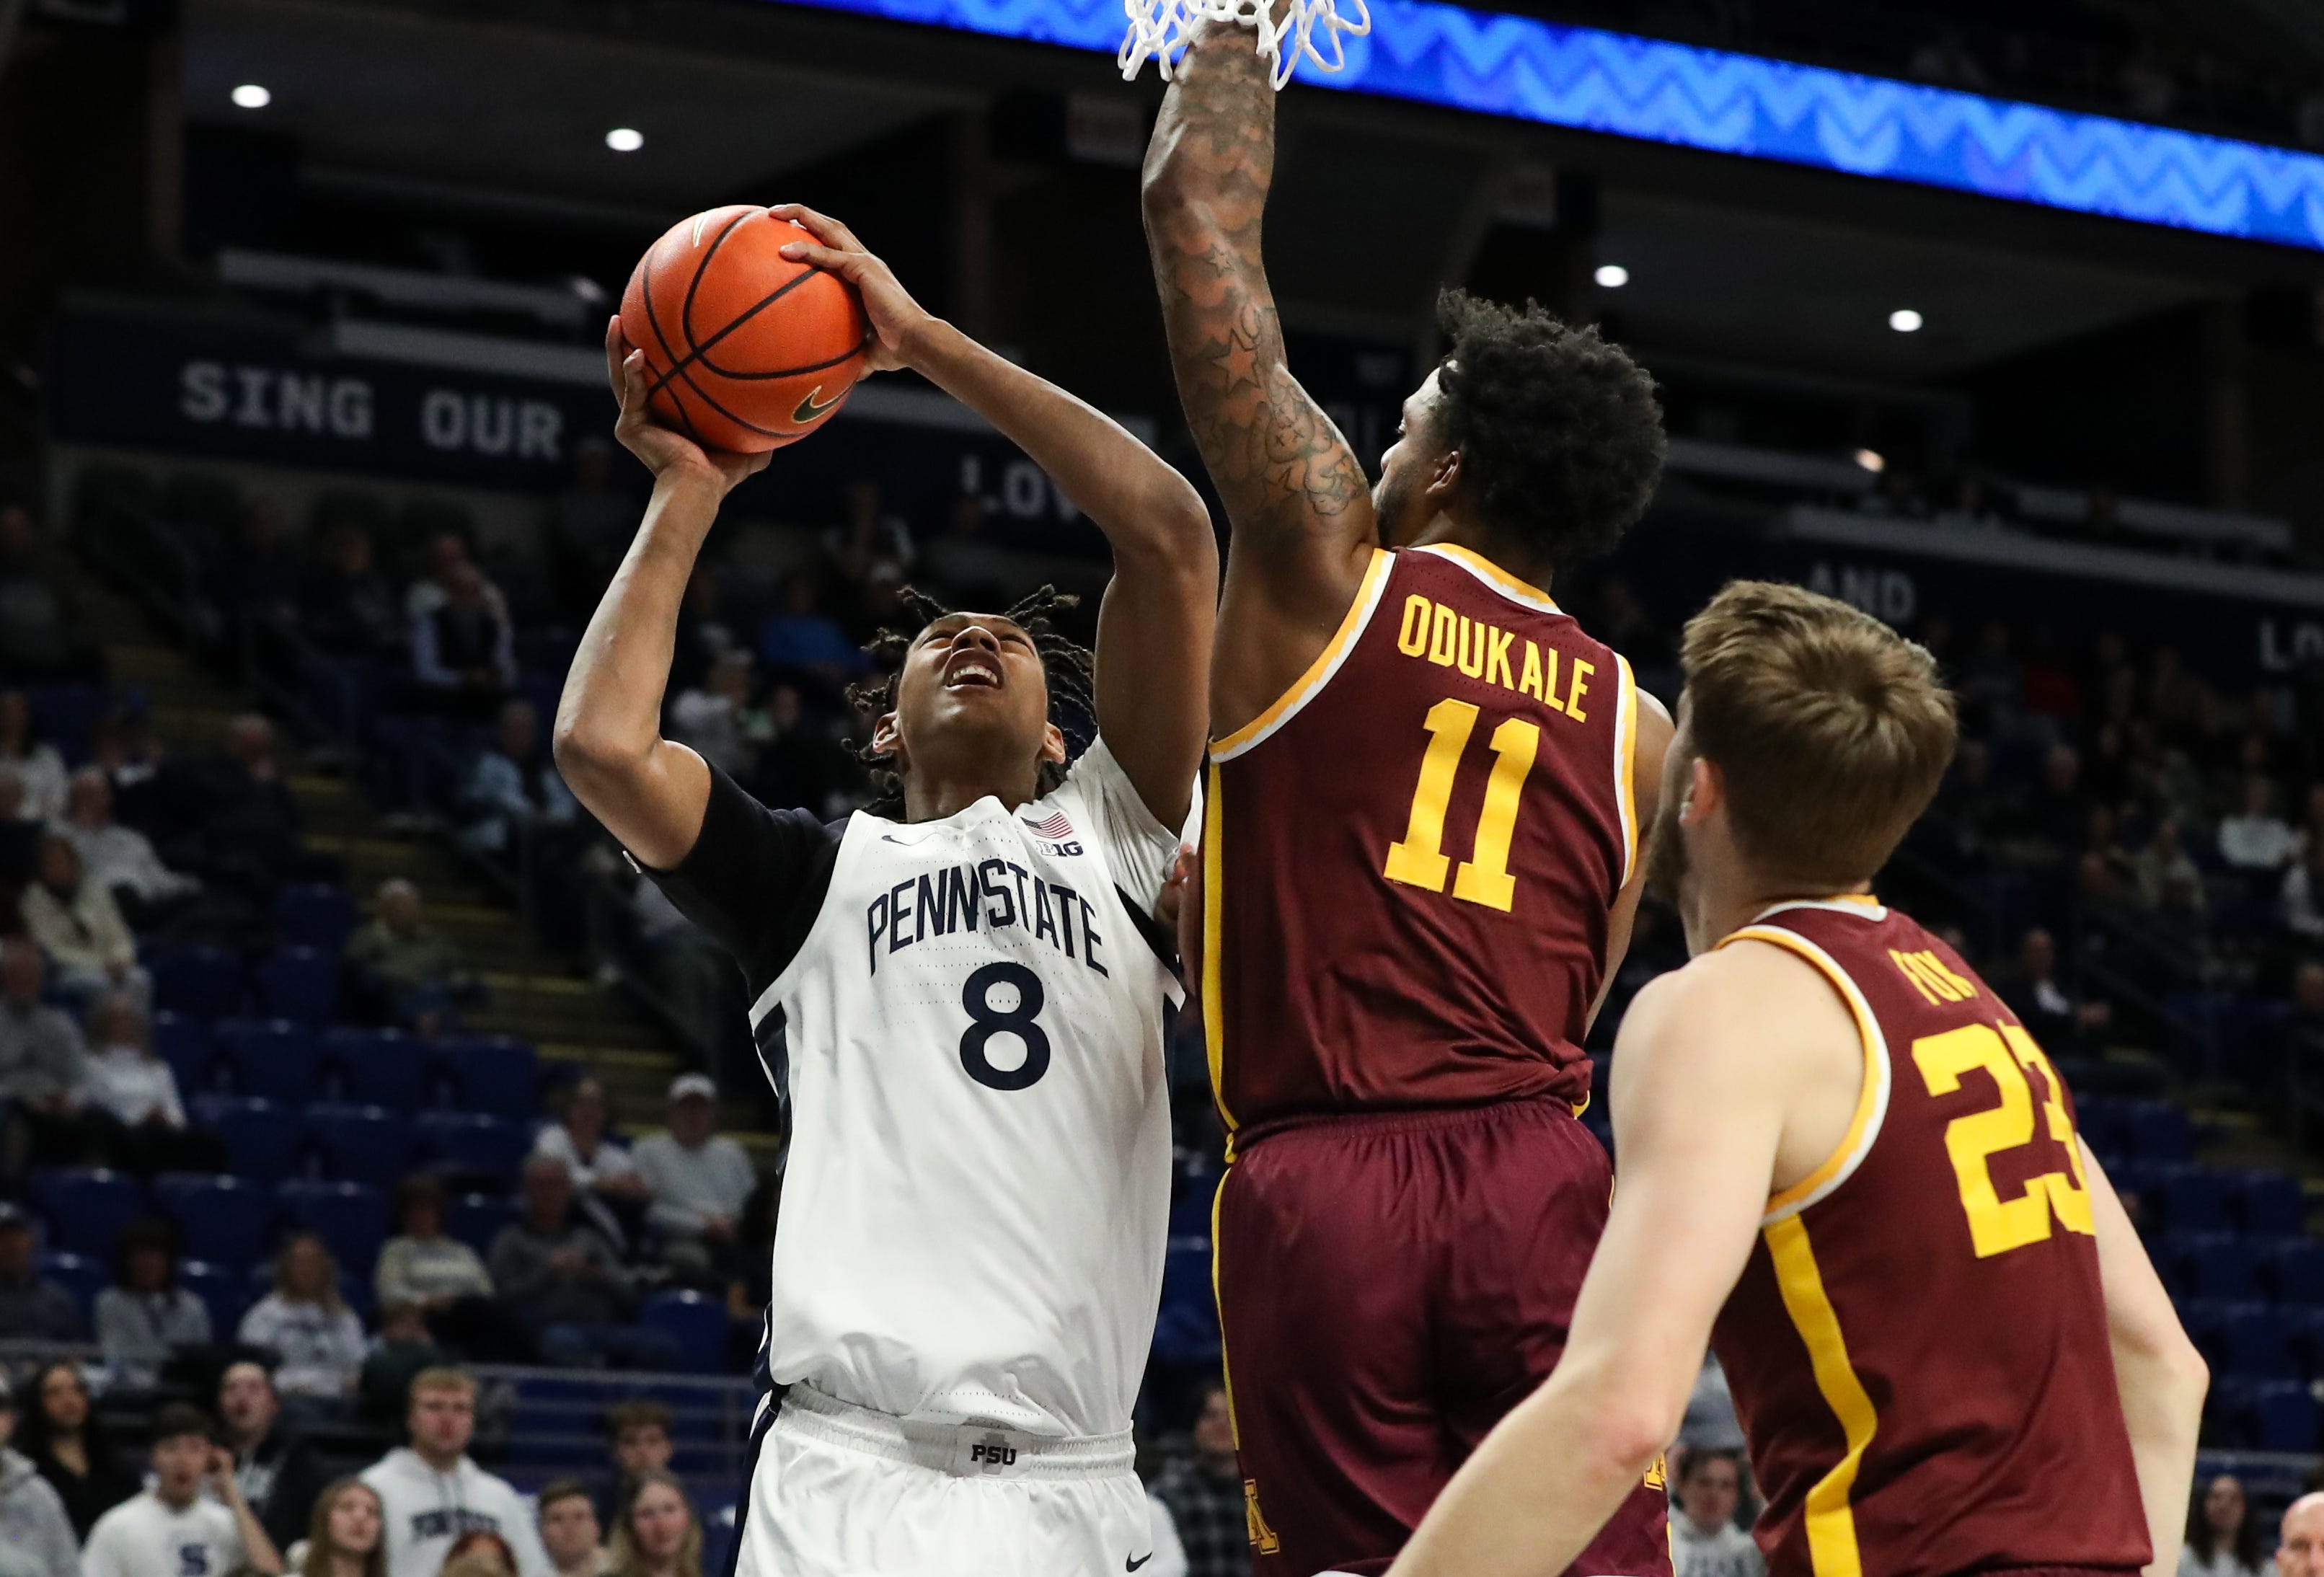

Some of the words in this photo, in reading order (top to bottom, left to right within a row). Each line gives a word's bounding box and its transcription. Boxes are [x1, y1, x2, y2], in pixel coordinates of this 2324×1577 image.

[179, 361, 374, 440] SING
[420, 387, 565, 462] OUR
[1397, 593, 1595, 723] ODUKALE
[1035, 841, 1084, 857] BIG
[1383, 697, 1541, 912] 11
[867, 867, 979, 977] PENN
[978, 858, 1109, 979] STATE
[960, 962, 1051, 1091] 8
[1912, 1019, 2096, 1260] 23
[971, 1444, 1017, 1466] PSU
